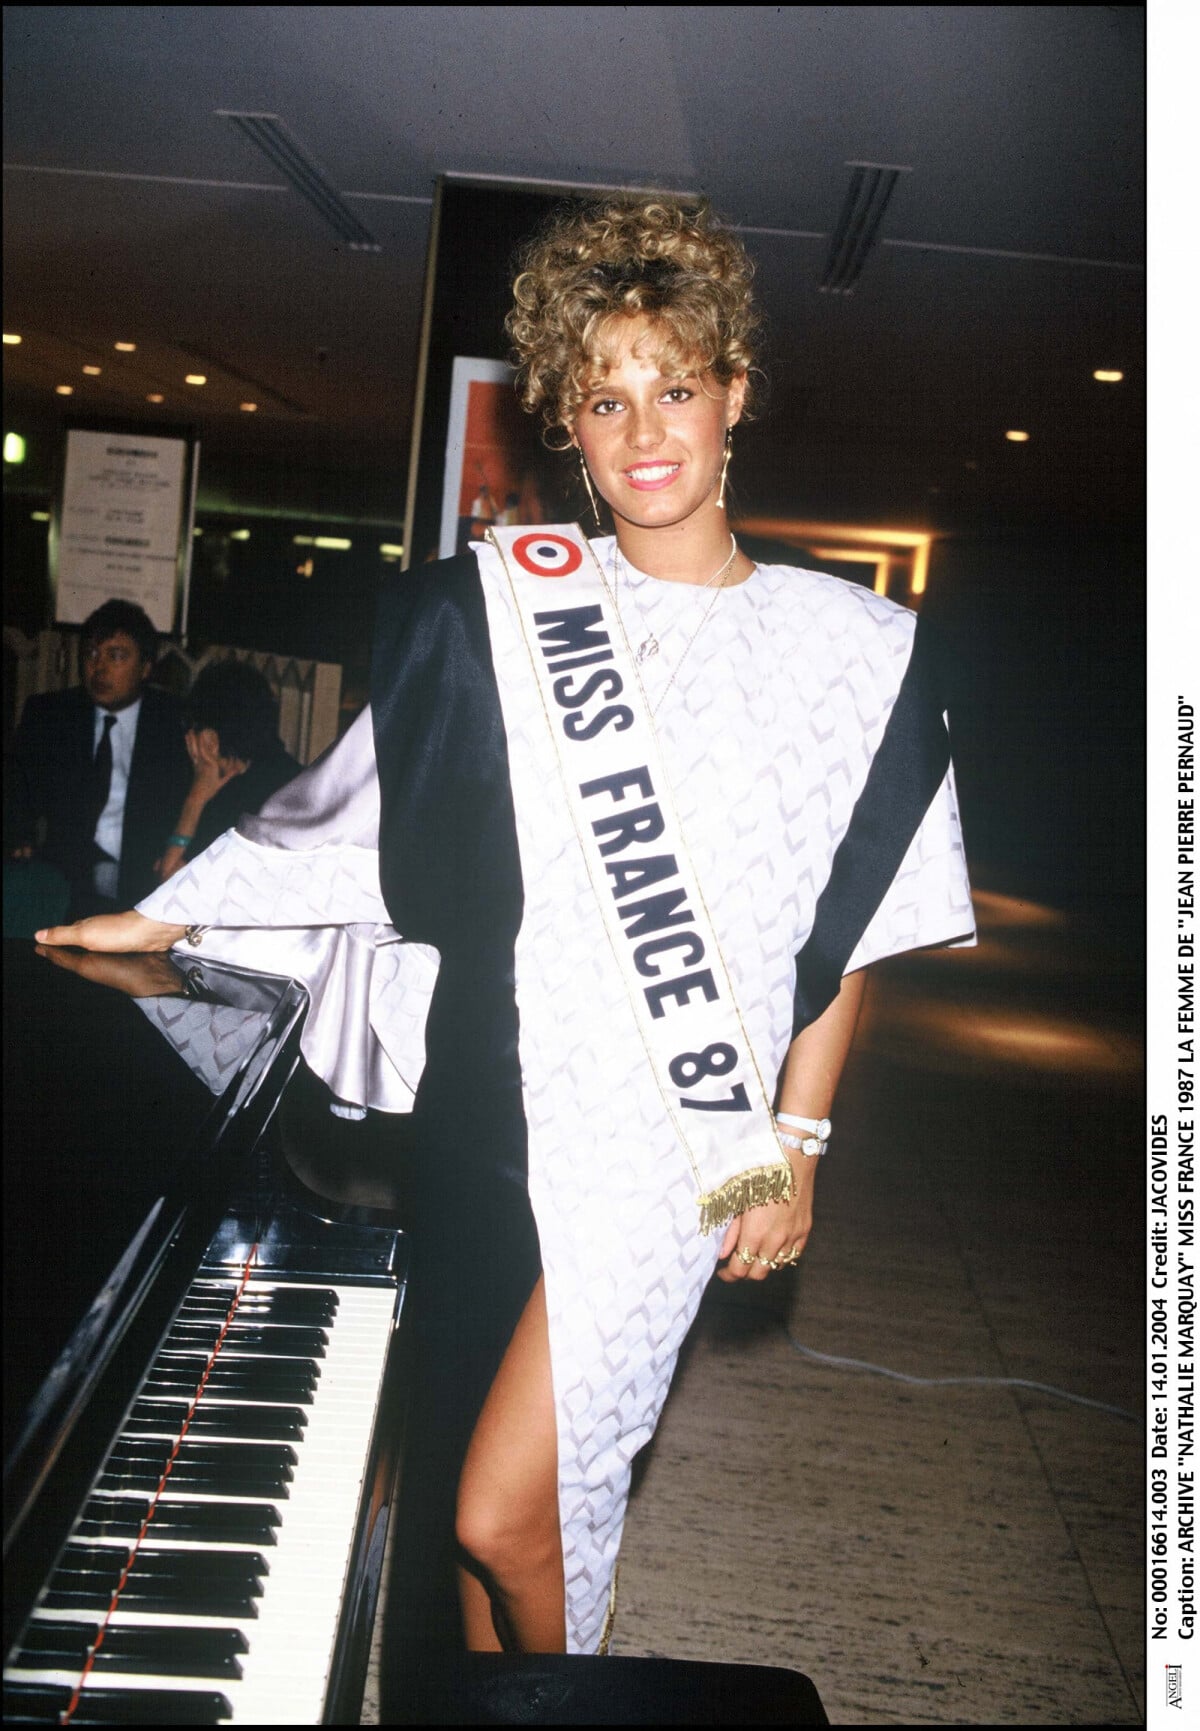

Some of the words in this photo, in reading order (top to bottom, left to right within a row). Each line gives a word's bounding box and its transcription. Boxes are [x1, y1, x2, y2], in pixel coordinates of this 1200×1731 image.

[533, 604, 635, 741] MISS
[579, 765, 719, 1019] FRANCE
[668, 1042, 752, 1113] 87
